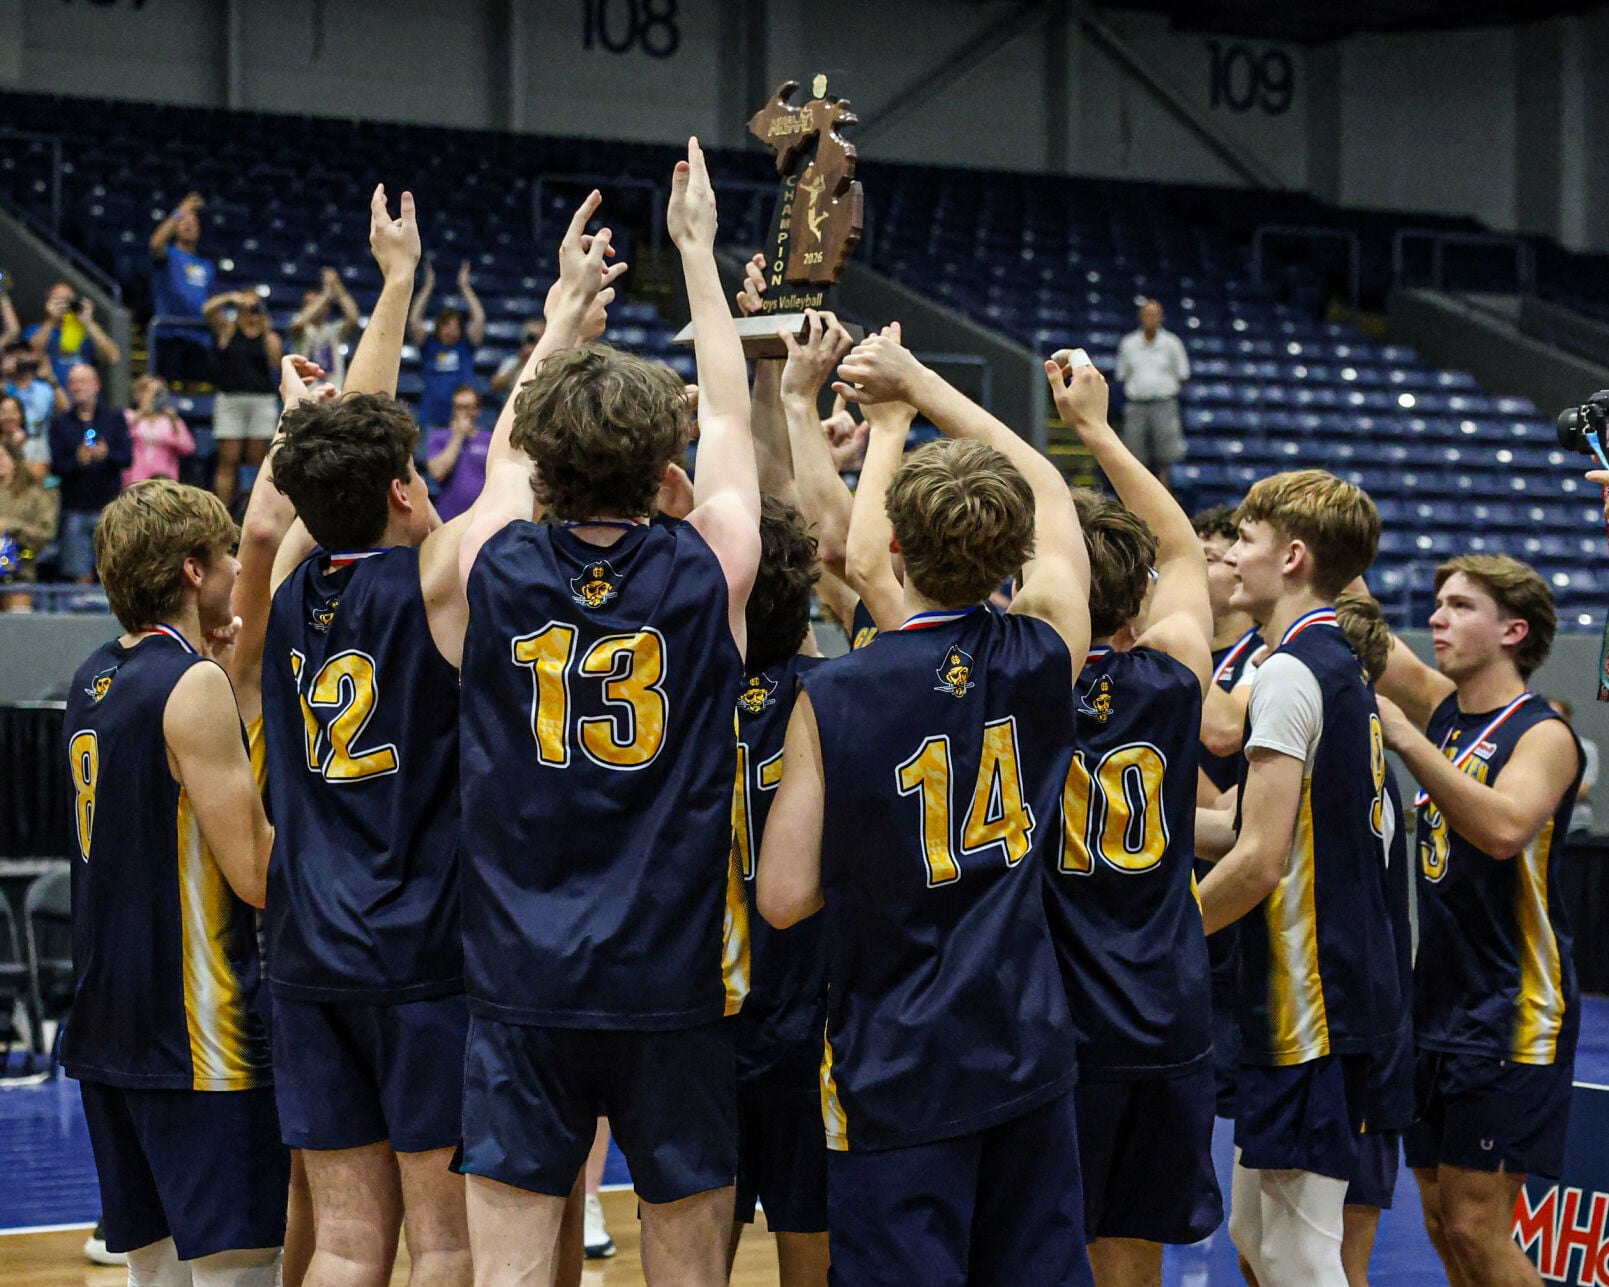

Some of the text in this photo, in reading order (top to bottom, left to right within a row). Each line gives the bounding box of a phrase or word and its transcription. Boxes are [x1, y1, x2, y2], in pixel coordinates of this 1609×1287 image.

[583, 0, 681, 58] 108
[1207, 41, 1295, 116] 109
[771, 175, 798, 286] CHAMPION
[803, 252, 824, 264] 2026
[762, 292, 823, 312] oys Volleyball
[512, 620, 669, 770] 13
[69, 730, 99, 863] 8
[895, 715, 1035, 888] 14
[1058, 742, 1169, 875] 10
[1510, 1183, 1609, 1287] MH
